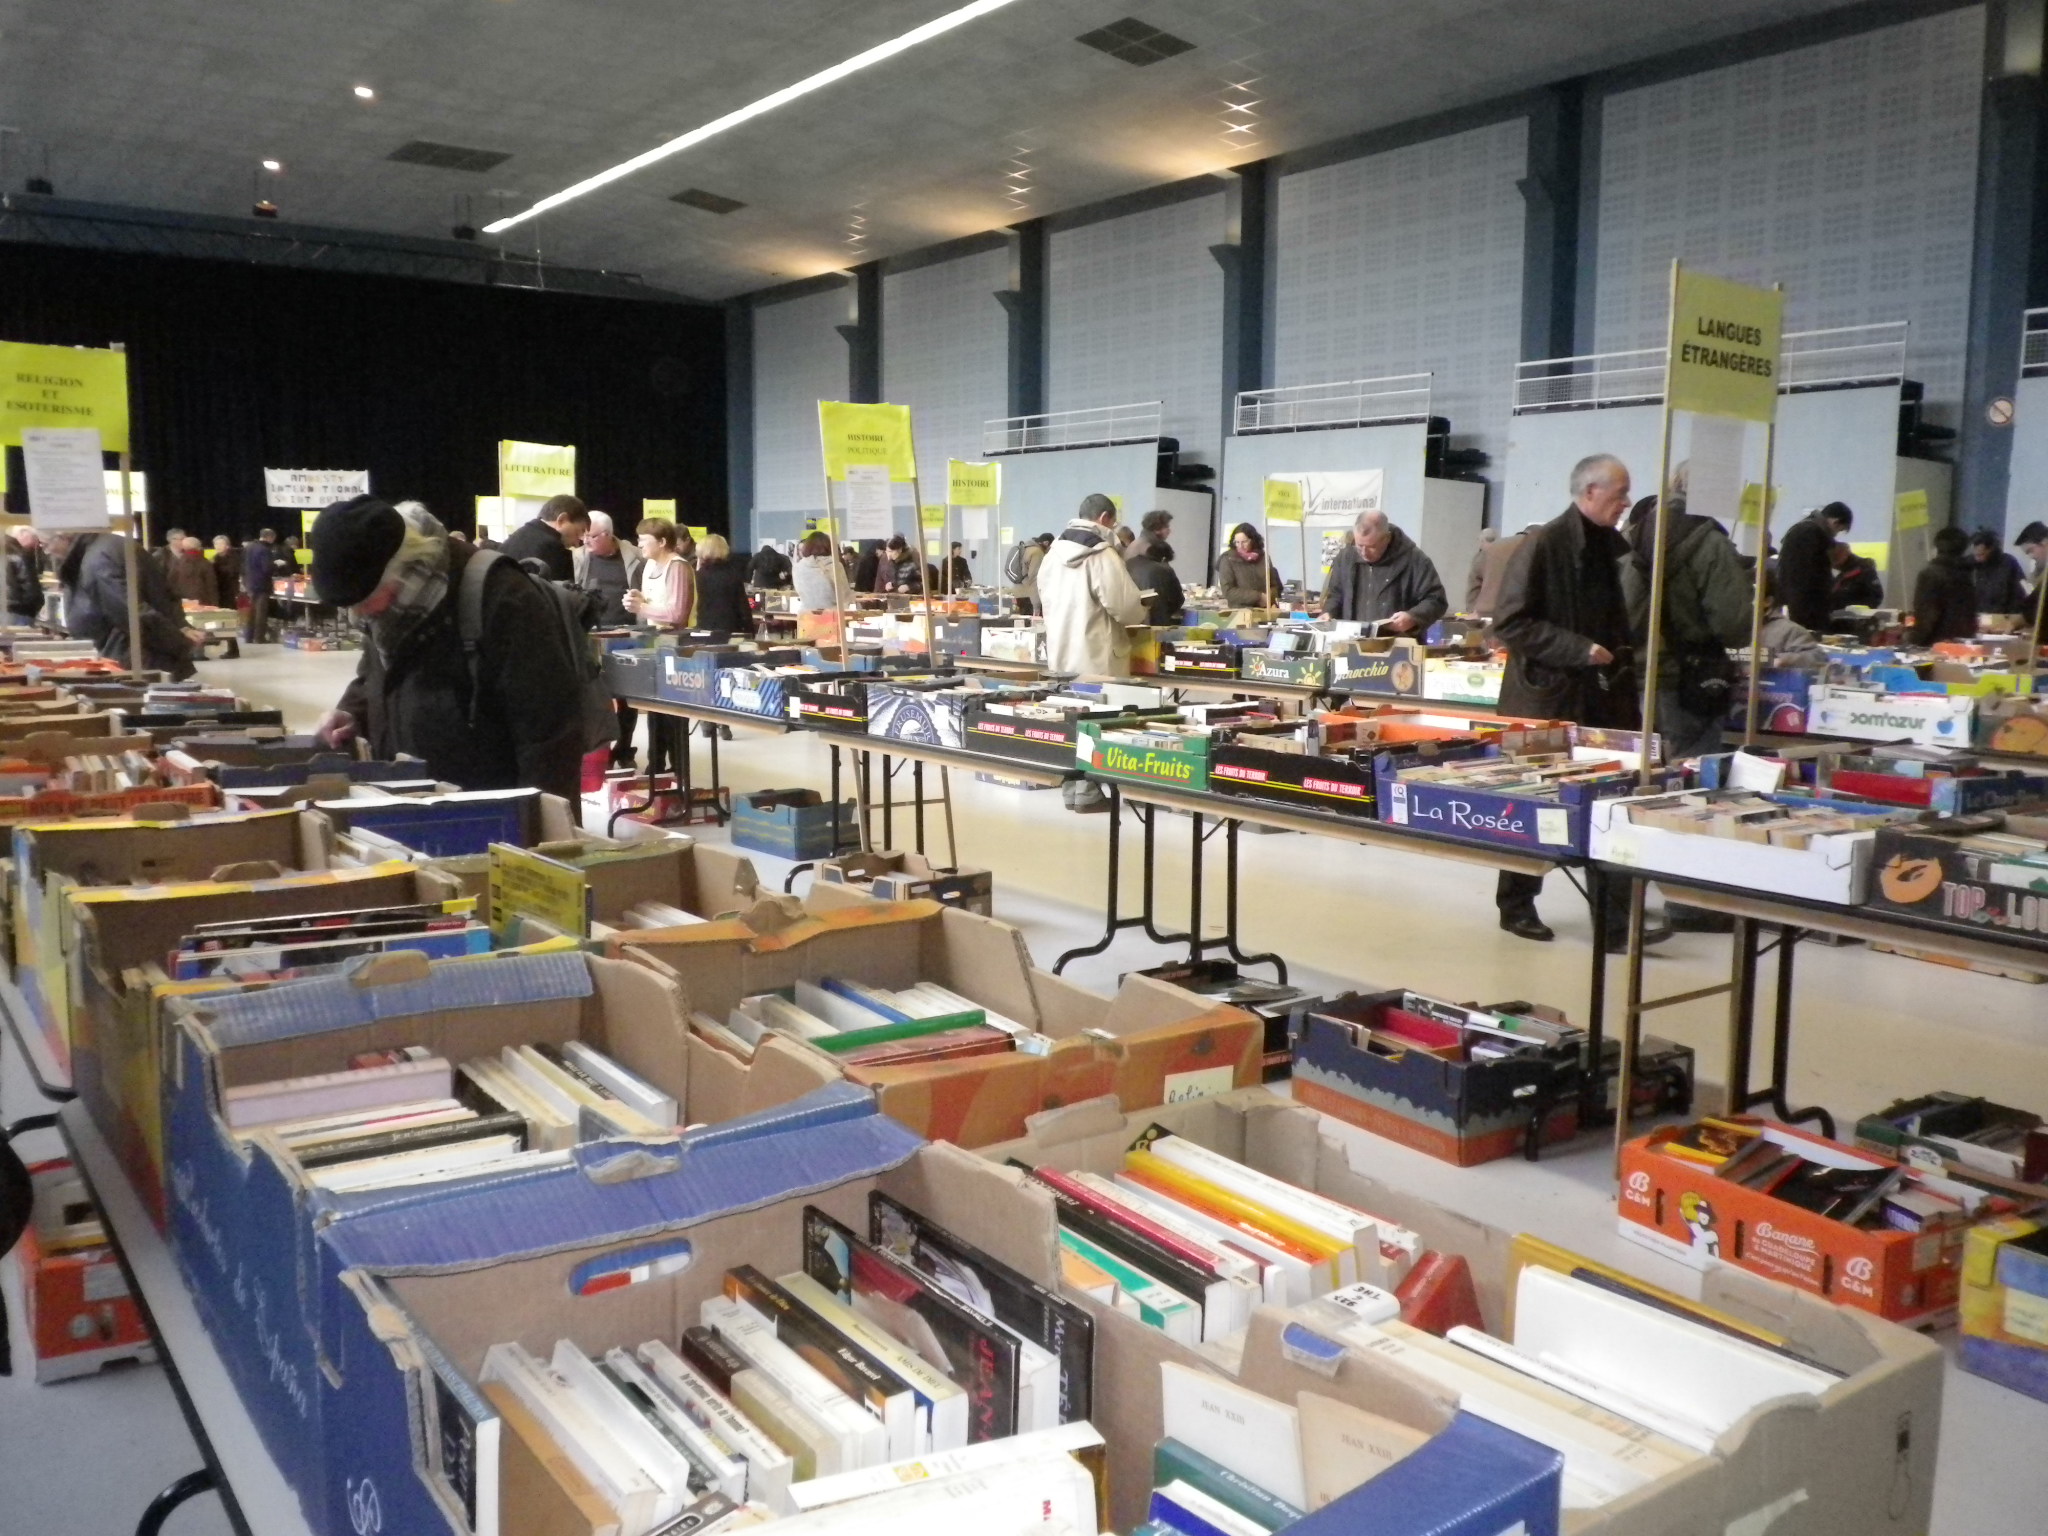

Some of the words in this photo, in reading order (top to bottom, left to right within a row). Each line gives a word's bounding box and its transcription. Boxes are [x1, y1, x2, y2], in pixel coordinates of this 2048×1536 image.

[1698, 316, 1762, 347] LANGUES
[1681, 339, 1773, 378] ÉTRANGÈRES
[16, 372, 84, 388] RELIGION
[42, 389, 59, 400] ET
[6, 400, 94, 417] ESOTERISME
[847, 433, 886, 443] HISTOIRE
[847, 446, 888, 456] POLITIQUE
[505, 463, 572, 477] LITTERATURE
[952, 478, 991, 489] HISTOIRE
[1259, 666, 1290, 679] Azura
[1106, 746, 1191, 779] Vita-Fruits
[1303, 778, 1313, 788] LES
[1313, 780, 1330, 791] FRUITS
[1330, 782, 1339, 792] DU
[1339, 784, 1362, 795] TERROIR
[1412, 795, 1443, 821] La
[1448, 800, 1526, 833] Rosée
[1942, 881, 1986, 919] TOP
[1756, 1222, 1816, 1250] Banane
[1201, 1400, 1221, 1416] JEAN
[1341, 1433, 1365, 1450] JEAN
[1219, 1469, 1272, 1503] Christian
